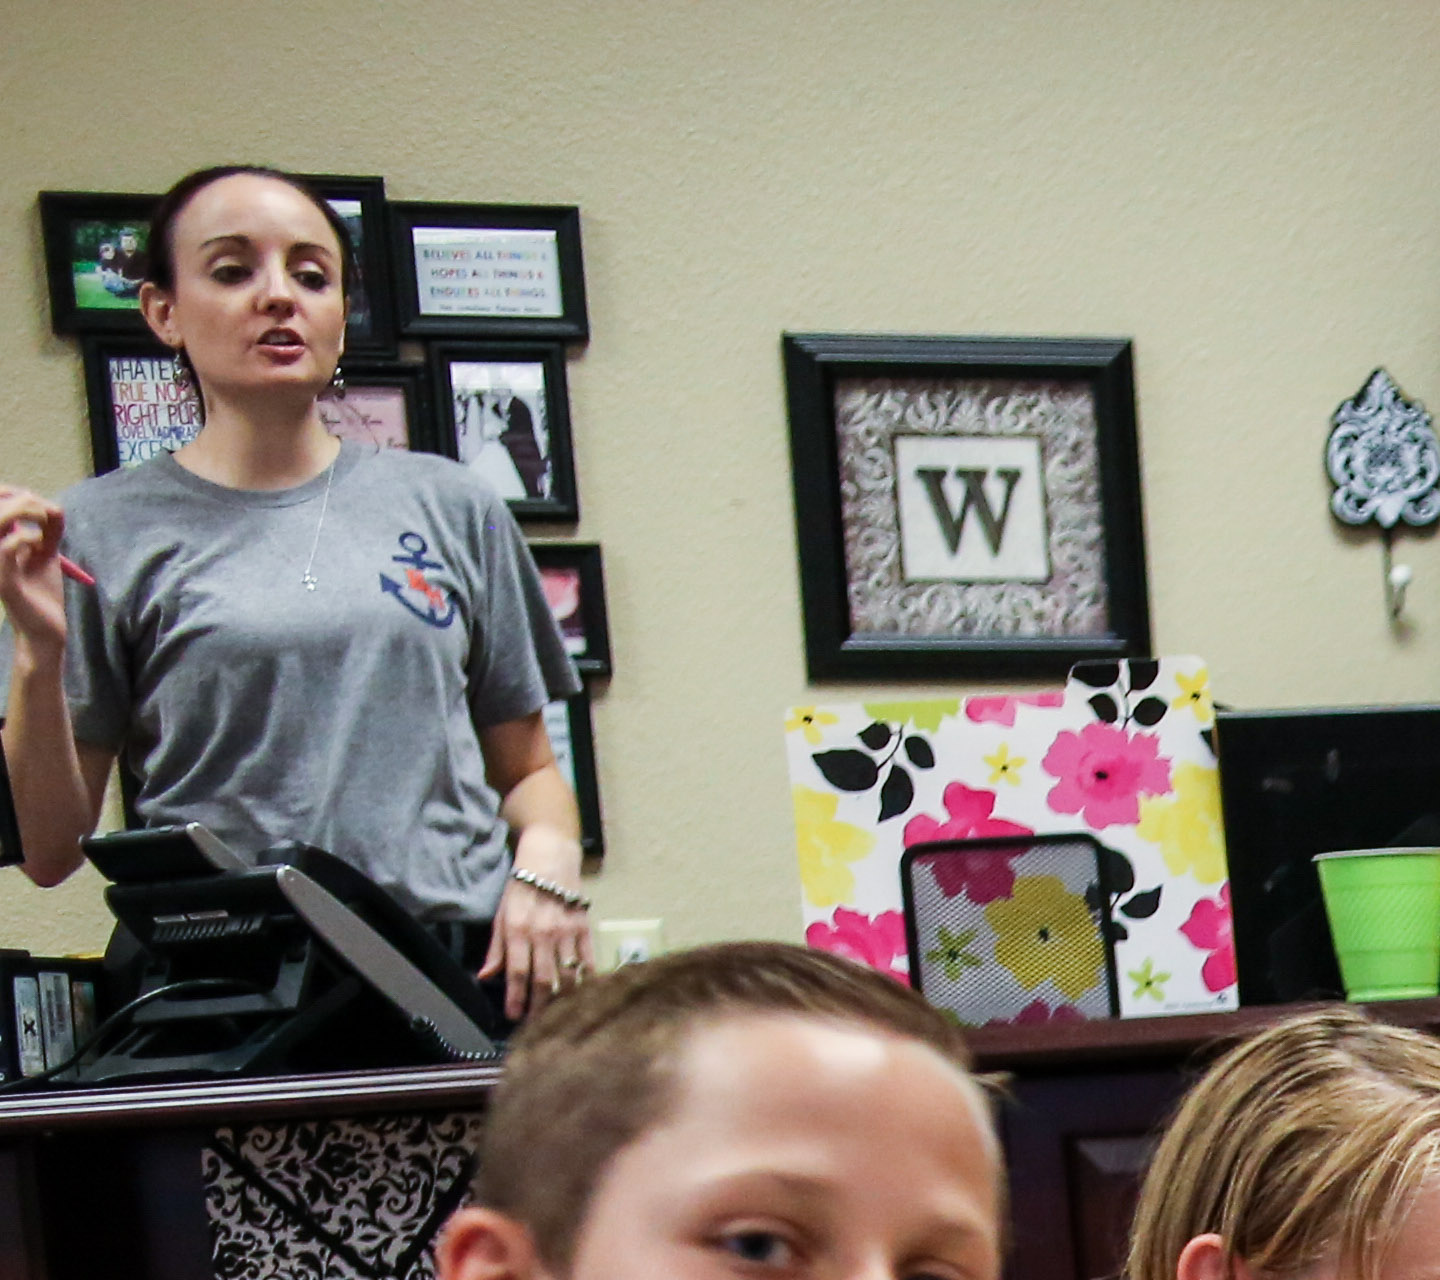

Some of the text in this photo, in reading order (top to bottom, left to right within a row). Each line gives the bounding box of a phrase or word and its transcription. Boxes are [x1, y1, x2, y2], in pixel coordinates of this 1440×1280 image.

[109, 360, 174, 380] WHATE
[113, 382, 149, 402] TRUE
[112, 403, 200, 426] RIGHT PUR
[915, 466, 1022, 557] W
